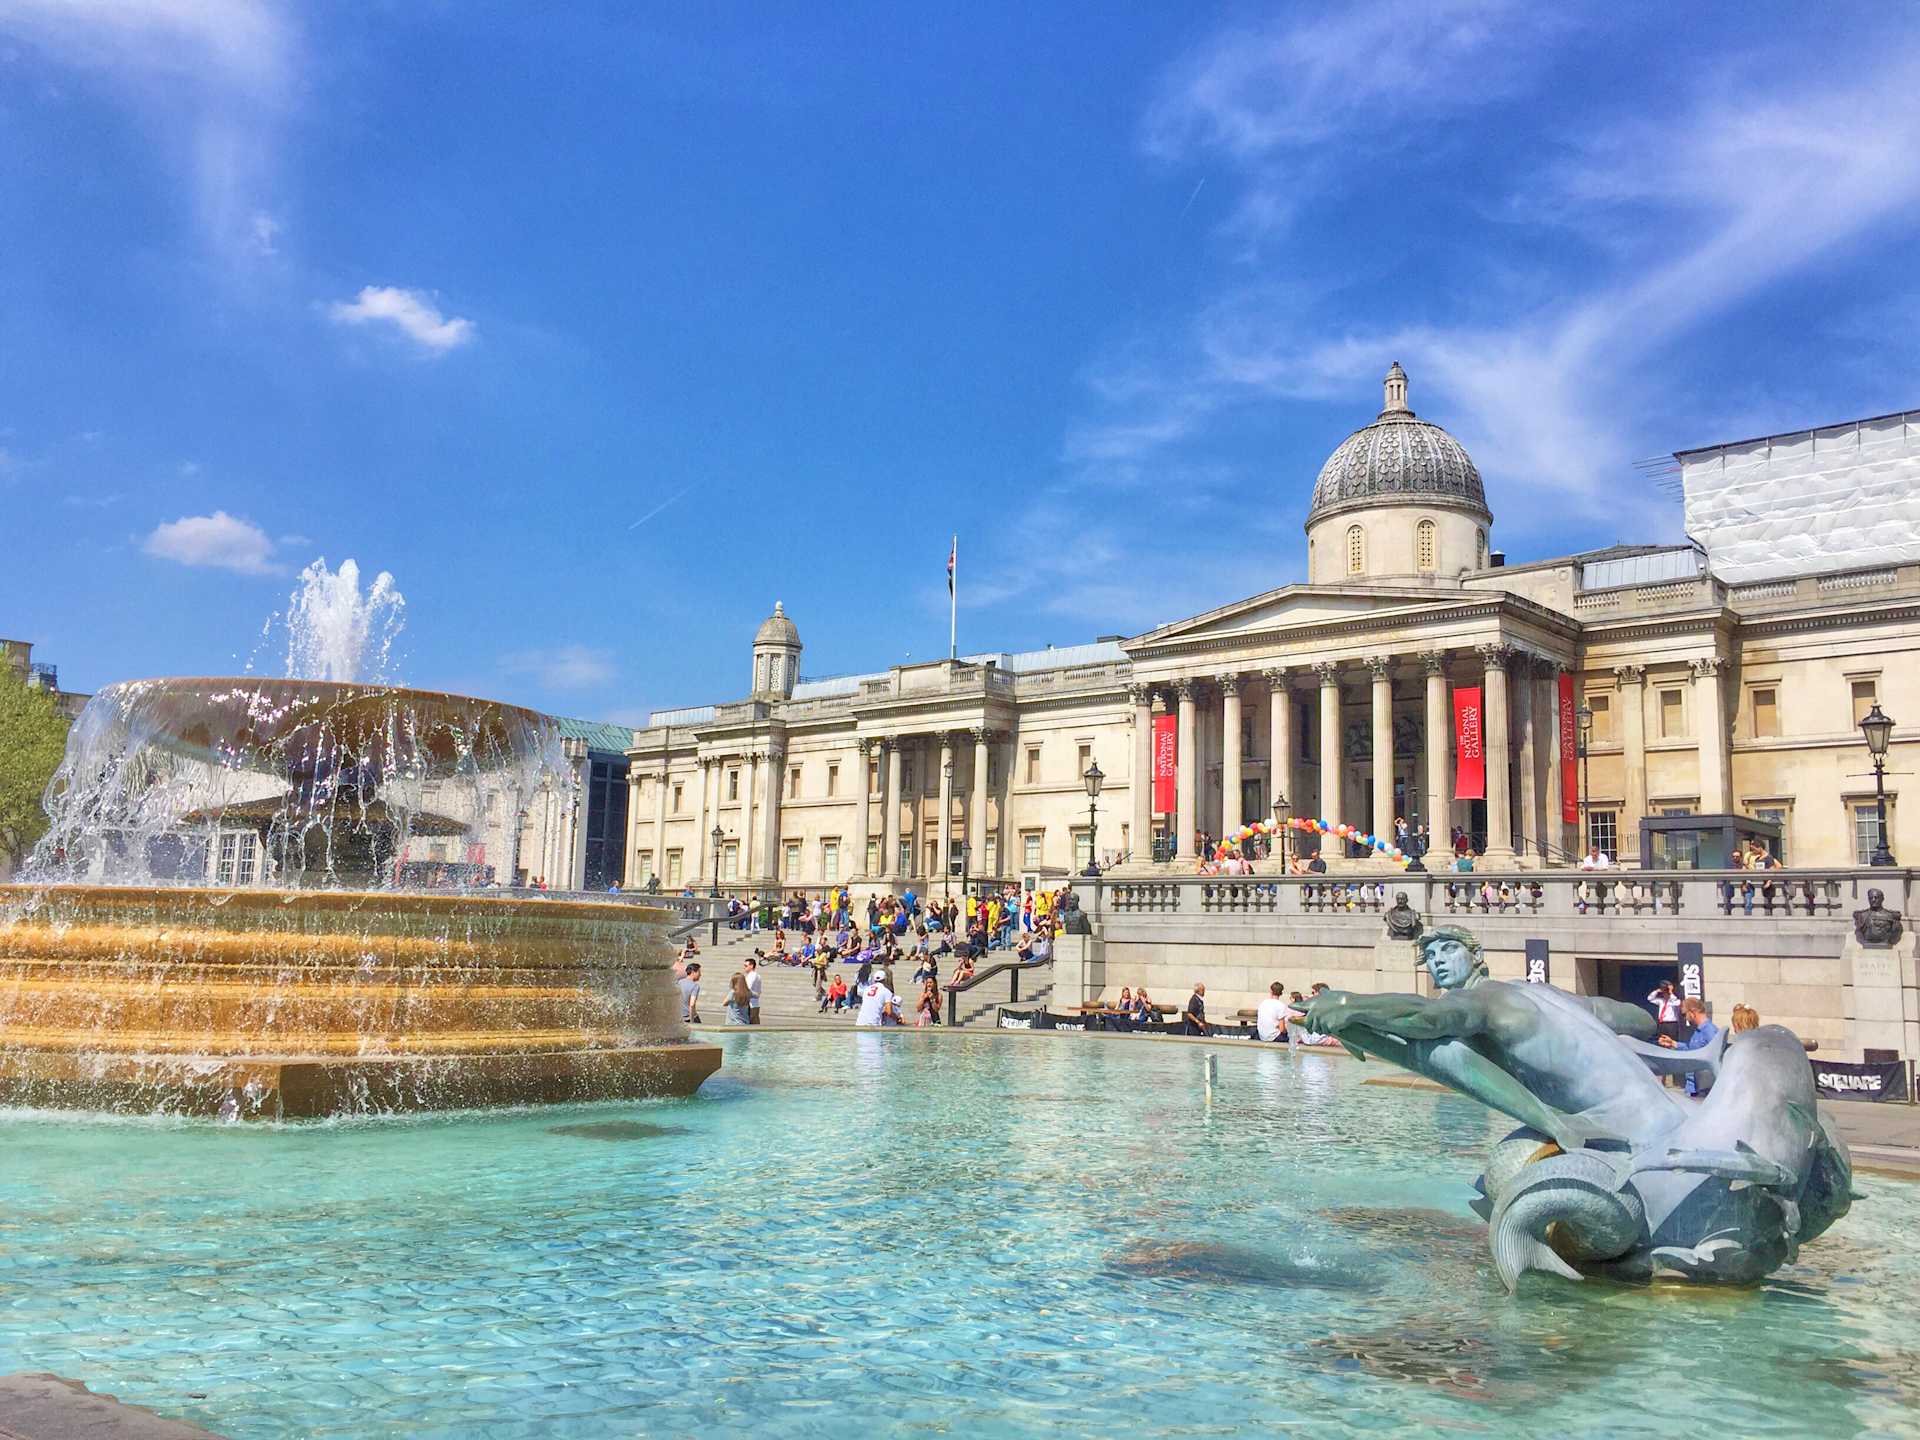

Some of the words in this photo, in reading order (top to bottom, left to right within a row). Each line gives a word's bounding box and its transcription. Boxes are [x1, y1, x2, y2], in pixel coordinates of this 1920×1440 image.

[1461, 706, 1472, 758] NATIONAL
[1469, 705, 1480, 758] GALLERY
[867, 985, 878, 997] 3
[1818, 1072, 1881, 1092] SQUARE
